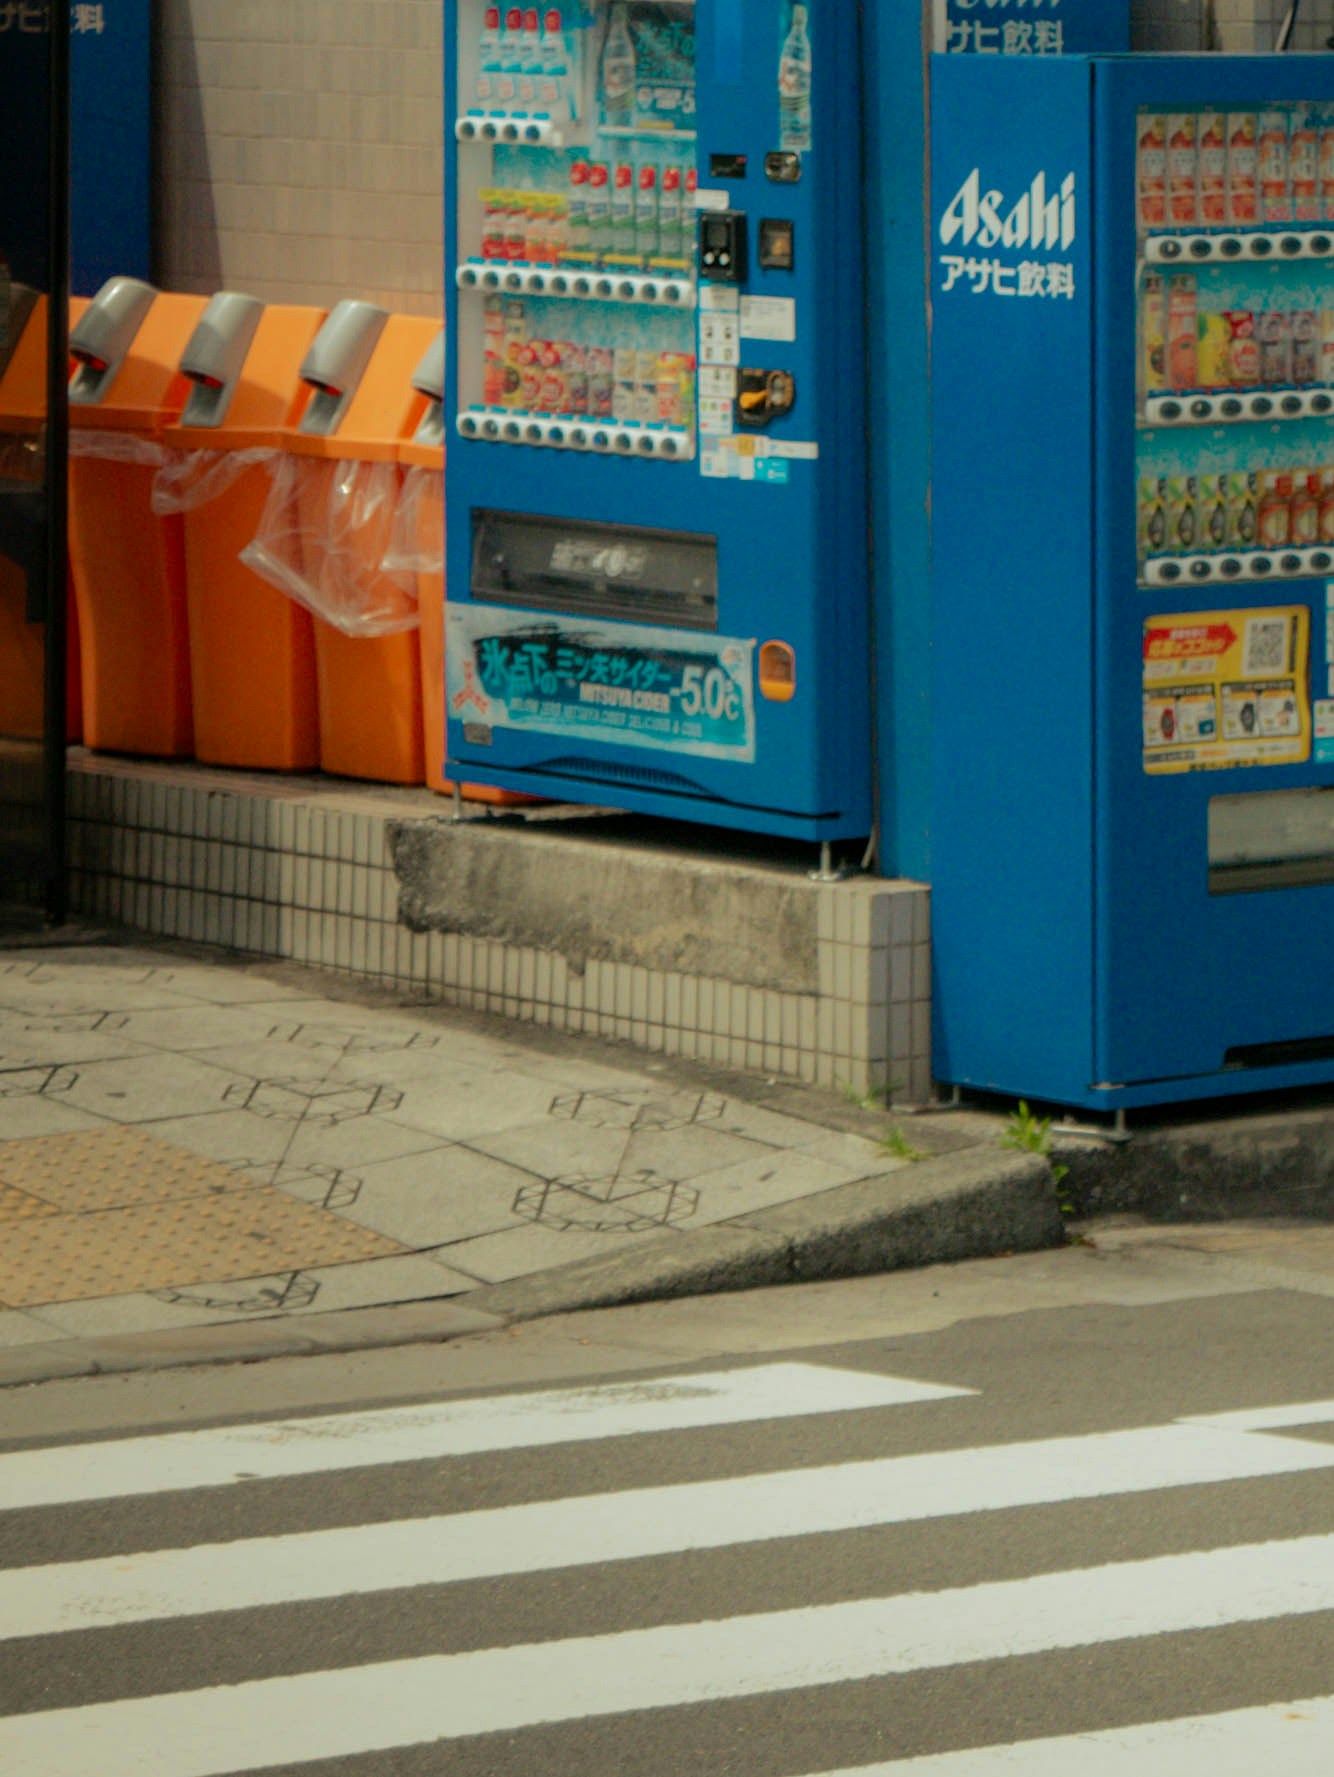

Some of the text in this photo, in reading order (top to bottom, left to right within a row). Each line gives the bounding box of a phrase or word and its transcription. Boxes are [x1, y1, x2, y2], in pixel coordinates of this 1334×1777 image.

[939, 167, 1076, 252] Asahi
[939, 255, 1076, 300] アサヒ飲料
